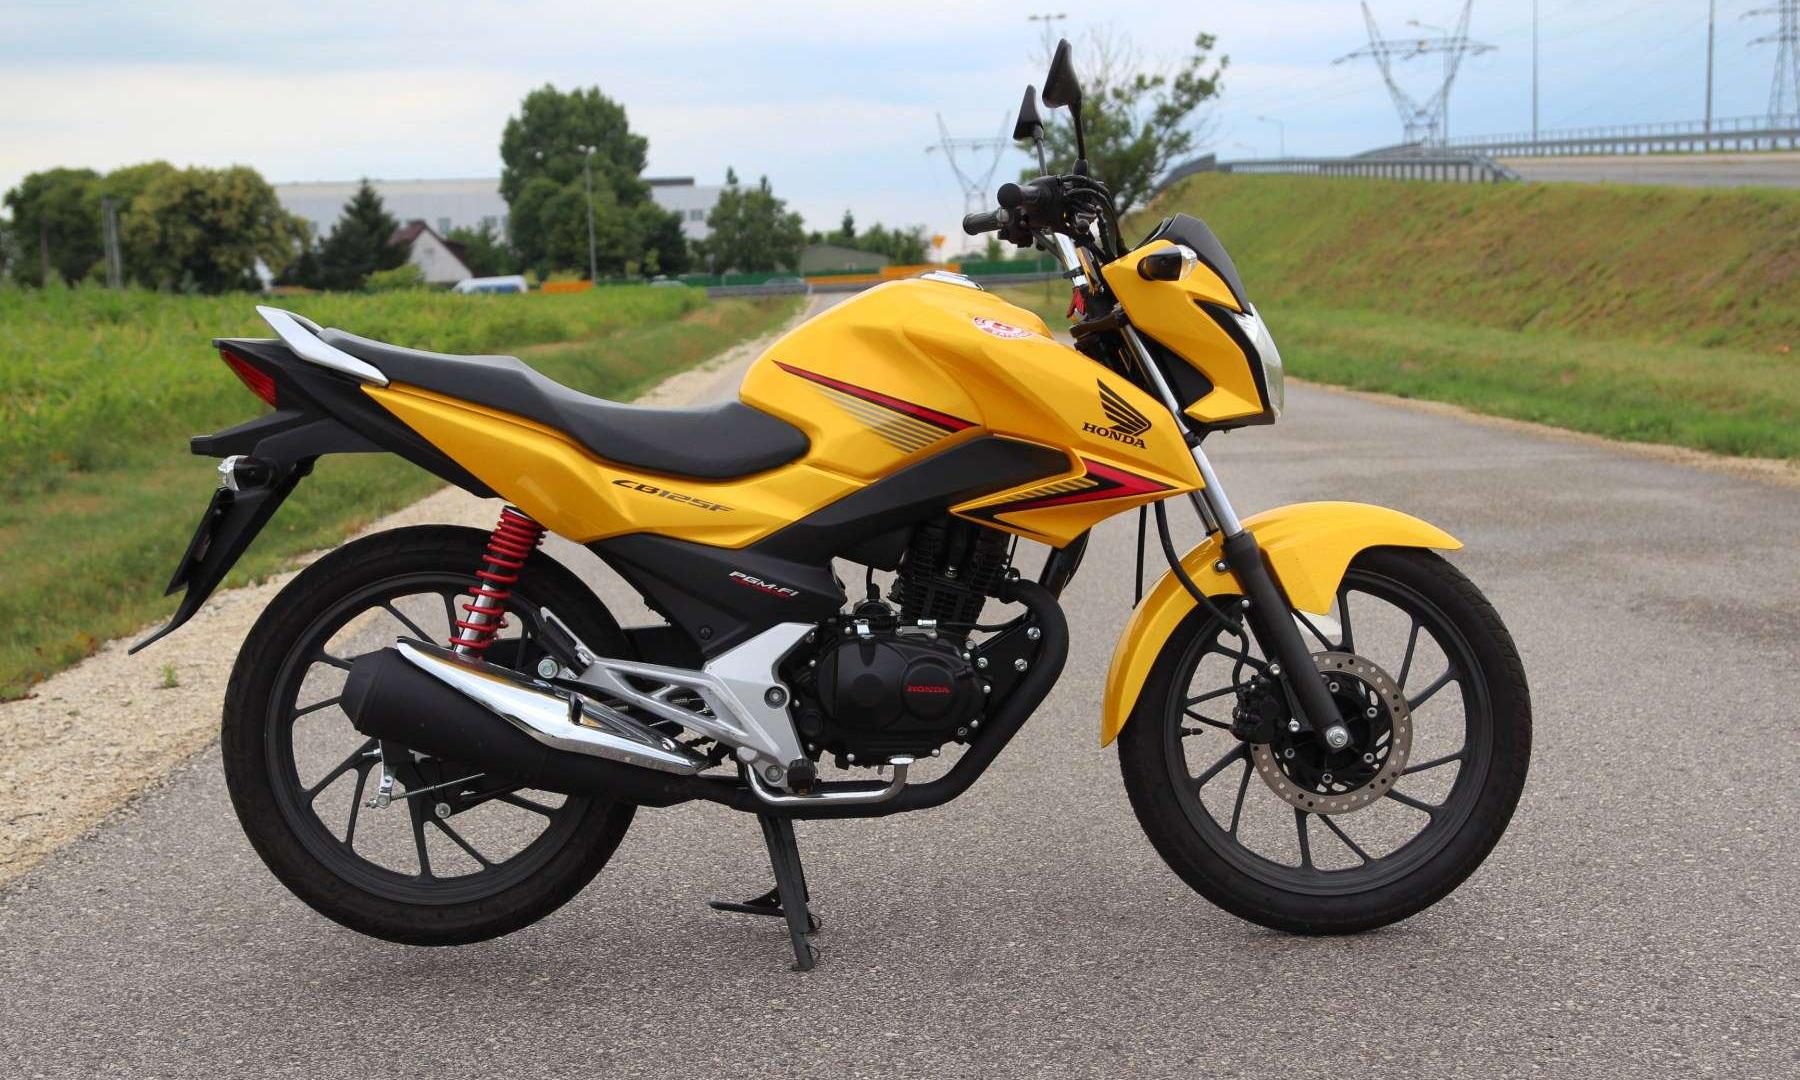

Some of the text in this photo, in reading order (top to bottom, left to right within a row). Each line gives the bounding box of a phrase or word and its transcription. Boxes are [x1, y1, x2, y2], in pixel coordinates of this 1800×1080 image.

[1082, 422, 1146, 449] HONDA
[612, 480, 734, 511] CB125F
[906, 684, 950, 694] HONDA
